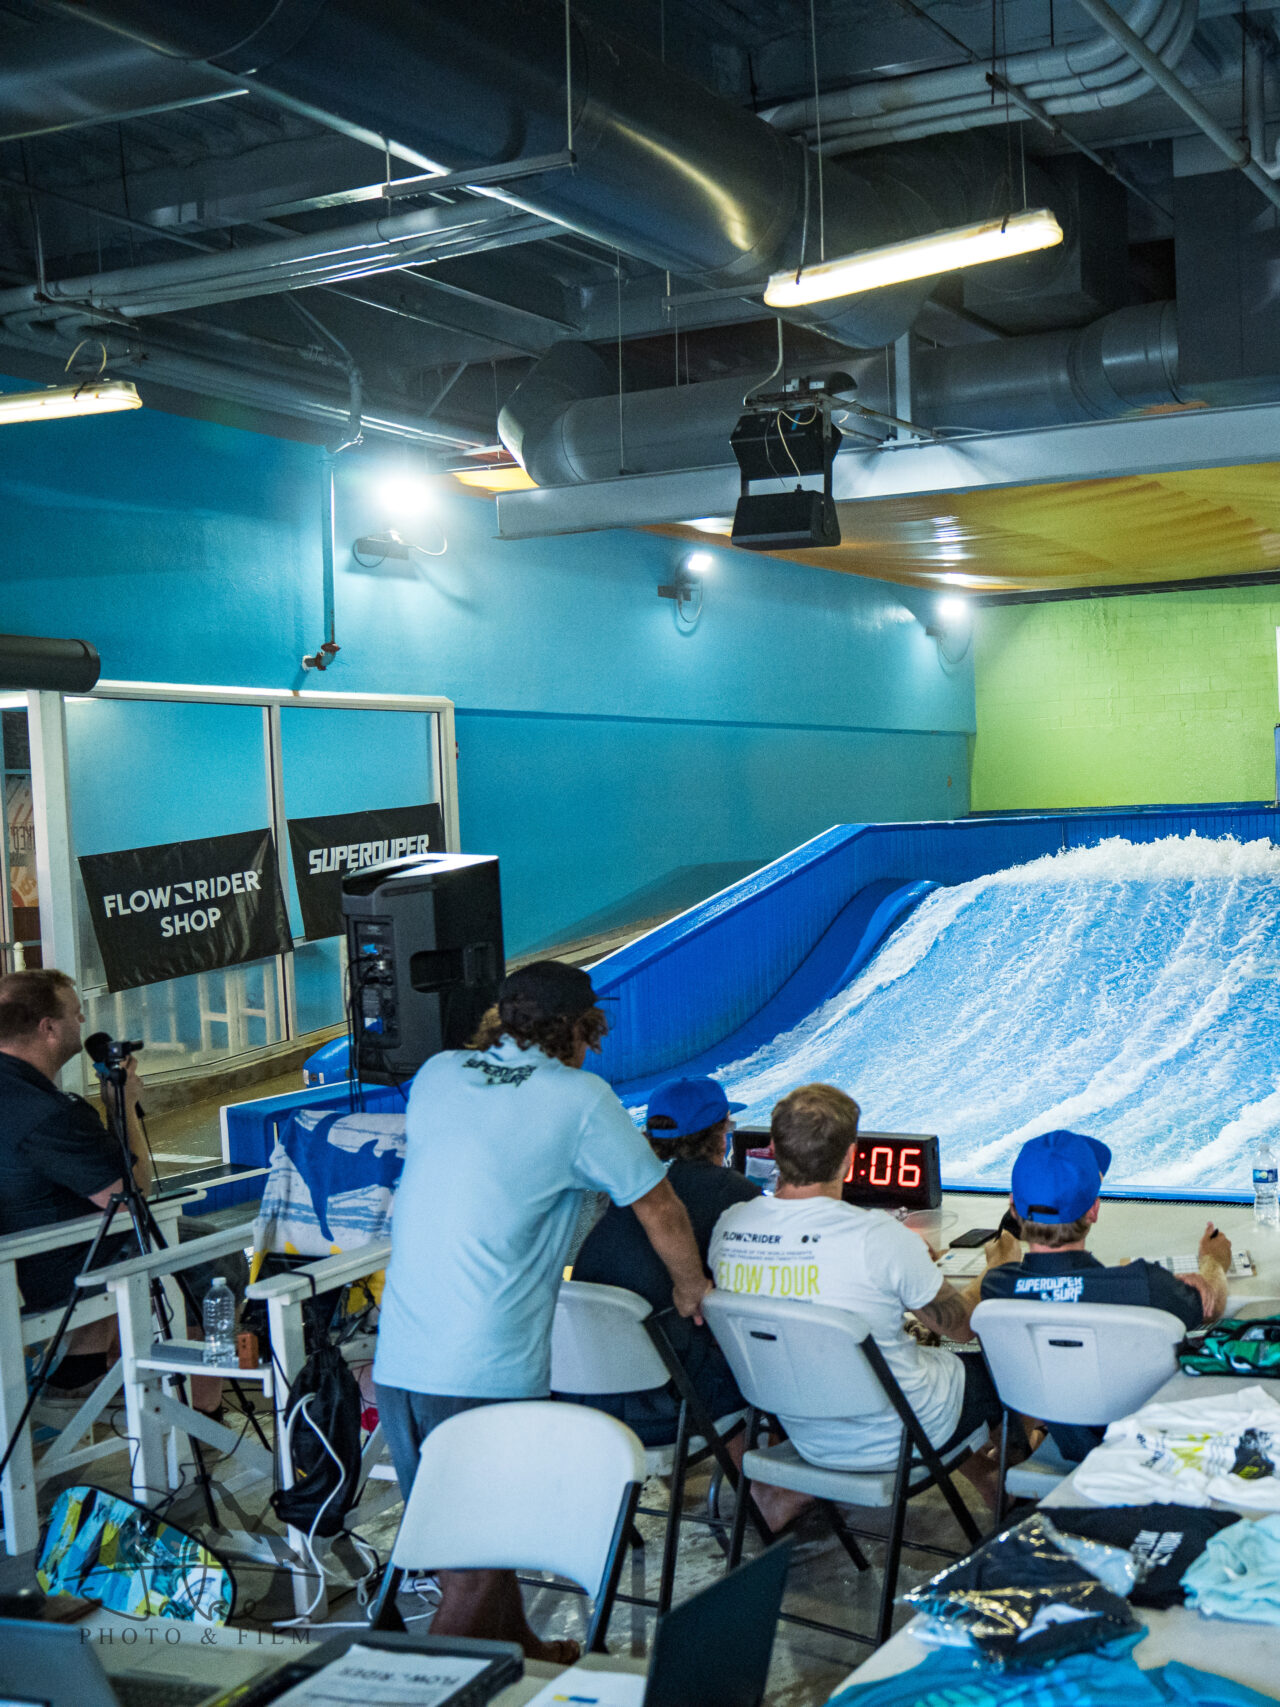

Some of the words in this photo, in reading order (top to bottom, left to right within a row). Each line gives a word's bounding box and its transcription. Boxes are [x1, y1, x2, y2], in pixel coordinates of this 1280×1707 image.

[160, 907, 222, 938] SHOP
[717, 1261, 763, 1294] FLOW
[768, 1264, 820, 1296] TOUR
